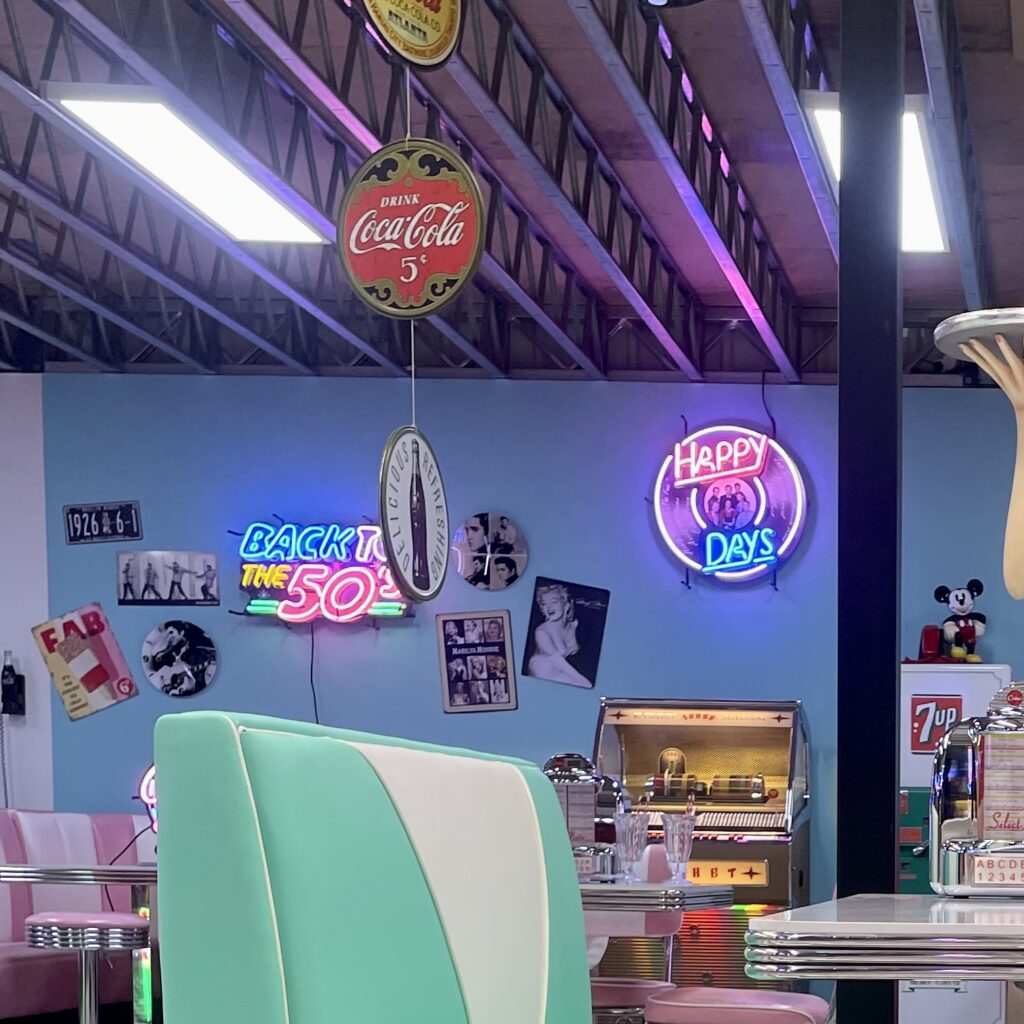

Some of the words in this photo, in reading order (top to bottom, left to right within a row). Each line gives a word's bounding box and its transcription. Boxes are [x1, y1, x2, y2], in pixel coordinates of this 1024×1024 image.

[387, 9, 429, 43] ATLANTA
[380, 193, 421, 208] DRINK
[349, 201, 470, 254] Coca-Cola
[674, 434, 768, 484] HAPPY
[68, 512, 99, 537] 1926
[388, 441, 410, 573] DELICIOUS
[422, 451, 446, 581] REFRESHING
[239, 522, 356, 562] BACK
[702, 527, 776, 573] DAYS
[242, 563, 292, 589] THE
[40, 610, 105, 654] FAB
